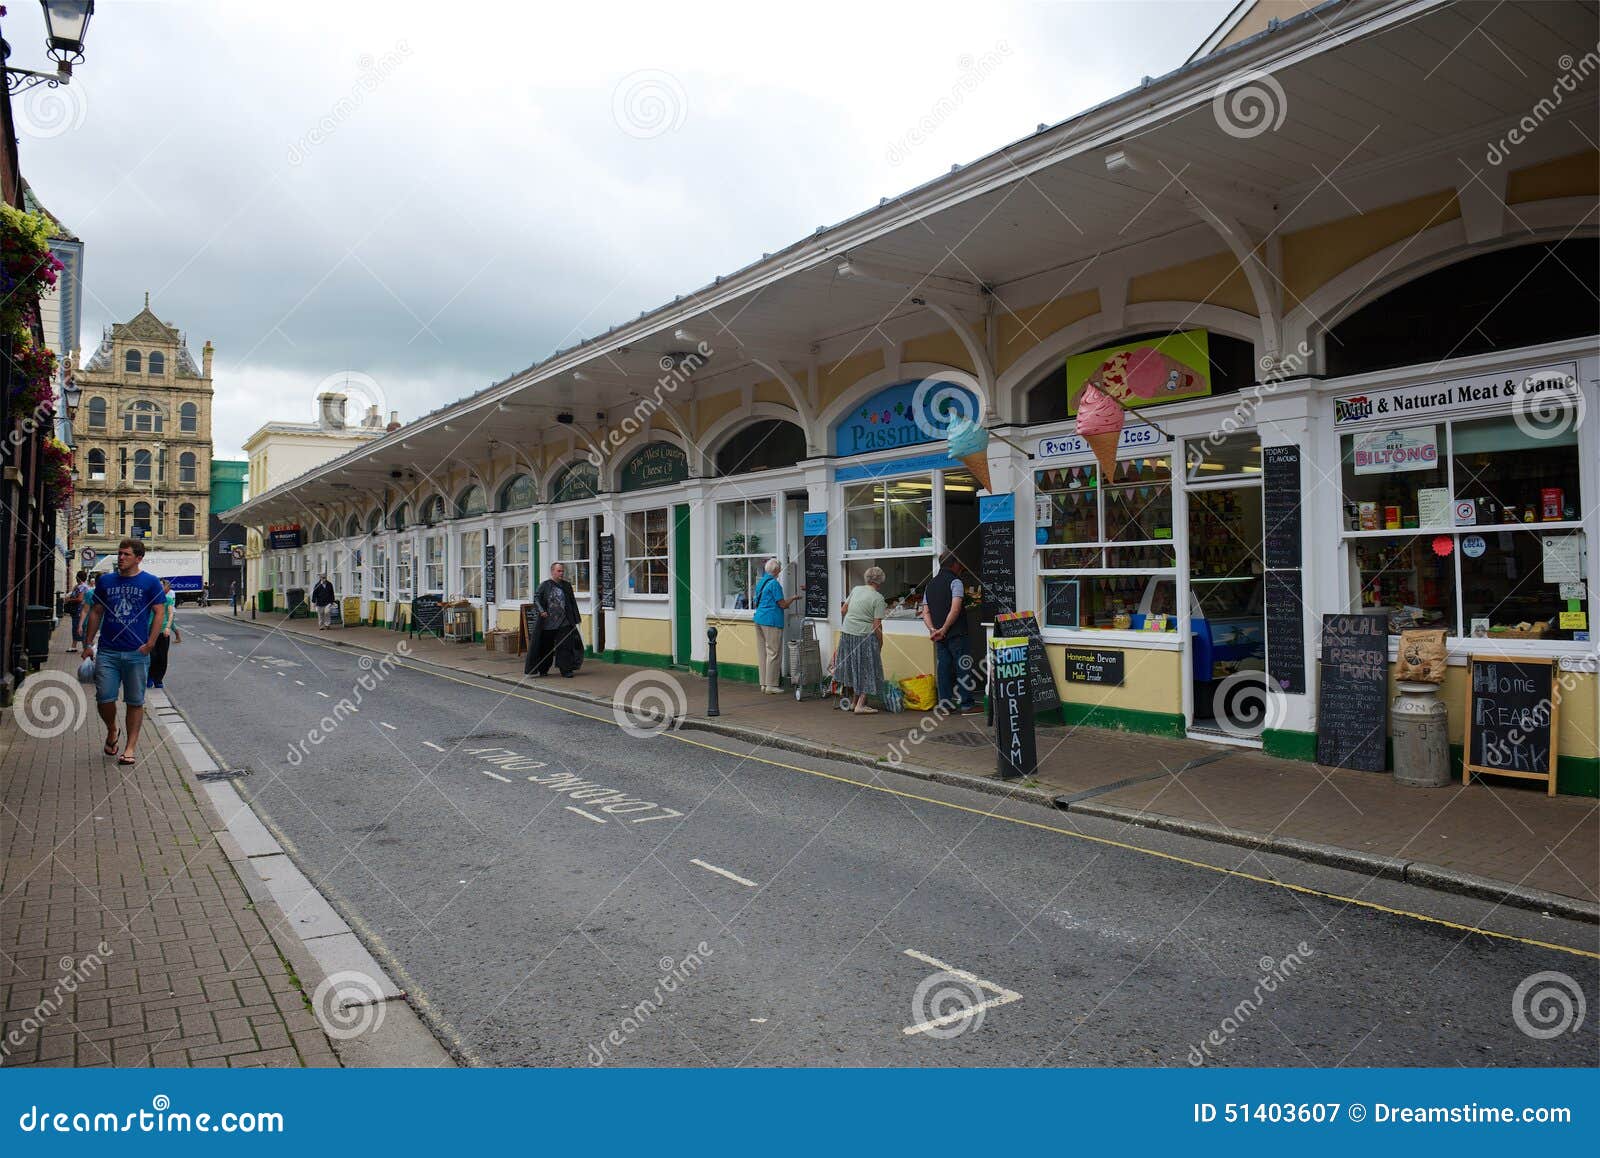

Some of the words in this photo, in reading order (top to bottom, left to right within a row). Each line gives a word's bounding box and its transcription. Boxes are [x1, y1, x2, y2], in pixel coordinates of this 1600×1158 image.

[1341, 397, 1373, 418] Wild
[1377, 398, 1389, 413] &
[1393, 388, 1453, 412] Natural
[1457, 382, 1498, 403] Meat
[1503, 379, 1516, 396] &
[1521, 374, 1576, 394] Game
[1123, 430, 1151, 443] Ices
[1045, 438, 1082, 455] Ryan's
[1265, 447, 1289, 456] TODAYS
[1355, 444, 1437, 467] BILTONG
[1269, 455, 1298, 464] FLAVOURS
[1326, 617, 1382, 635] LOCAL
[996, 647, 1028, 665] HOME
[1097, 653, 1117, 664] Devon
[996, 663, 1027, 679] MADE
[999, 680, 1026, 698] ICE
[463, 747, 549, 771] ONLY
[527, 772, 684, 824] LOADING
